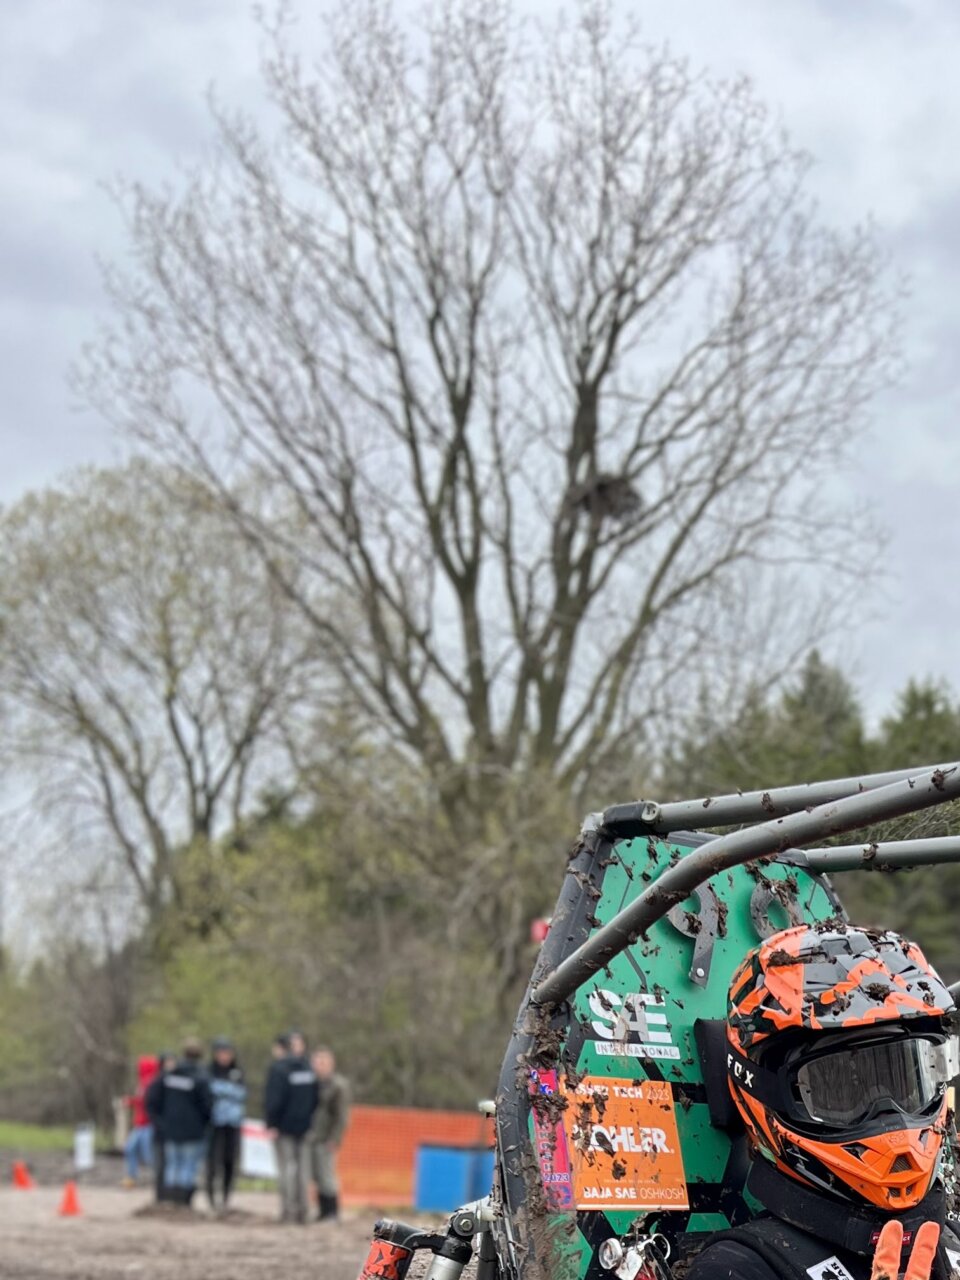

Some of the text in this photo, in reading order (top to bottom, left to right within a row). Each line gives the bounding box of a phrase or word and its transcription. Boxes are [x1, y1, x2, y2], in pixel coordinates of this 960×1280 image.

[589, 989, 672, 1043] SAE
[727, 1053, 754, 1088] FOX
[613, 1086, 643, 1099] TECH
[646, 1088, 670, 1100] 2023
[583, 1187, 684, 1200] BAJA SAE OSHKOSH
